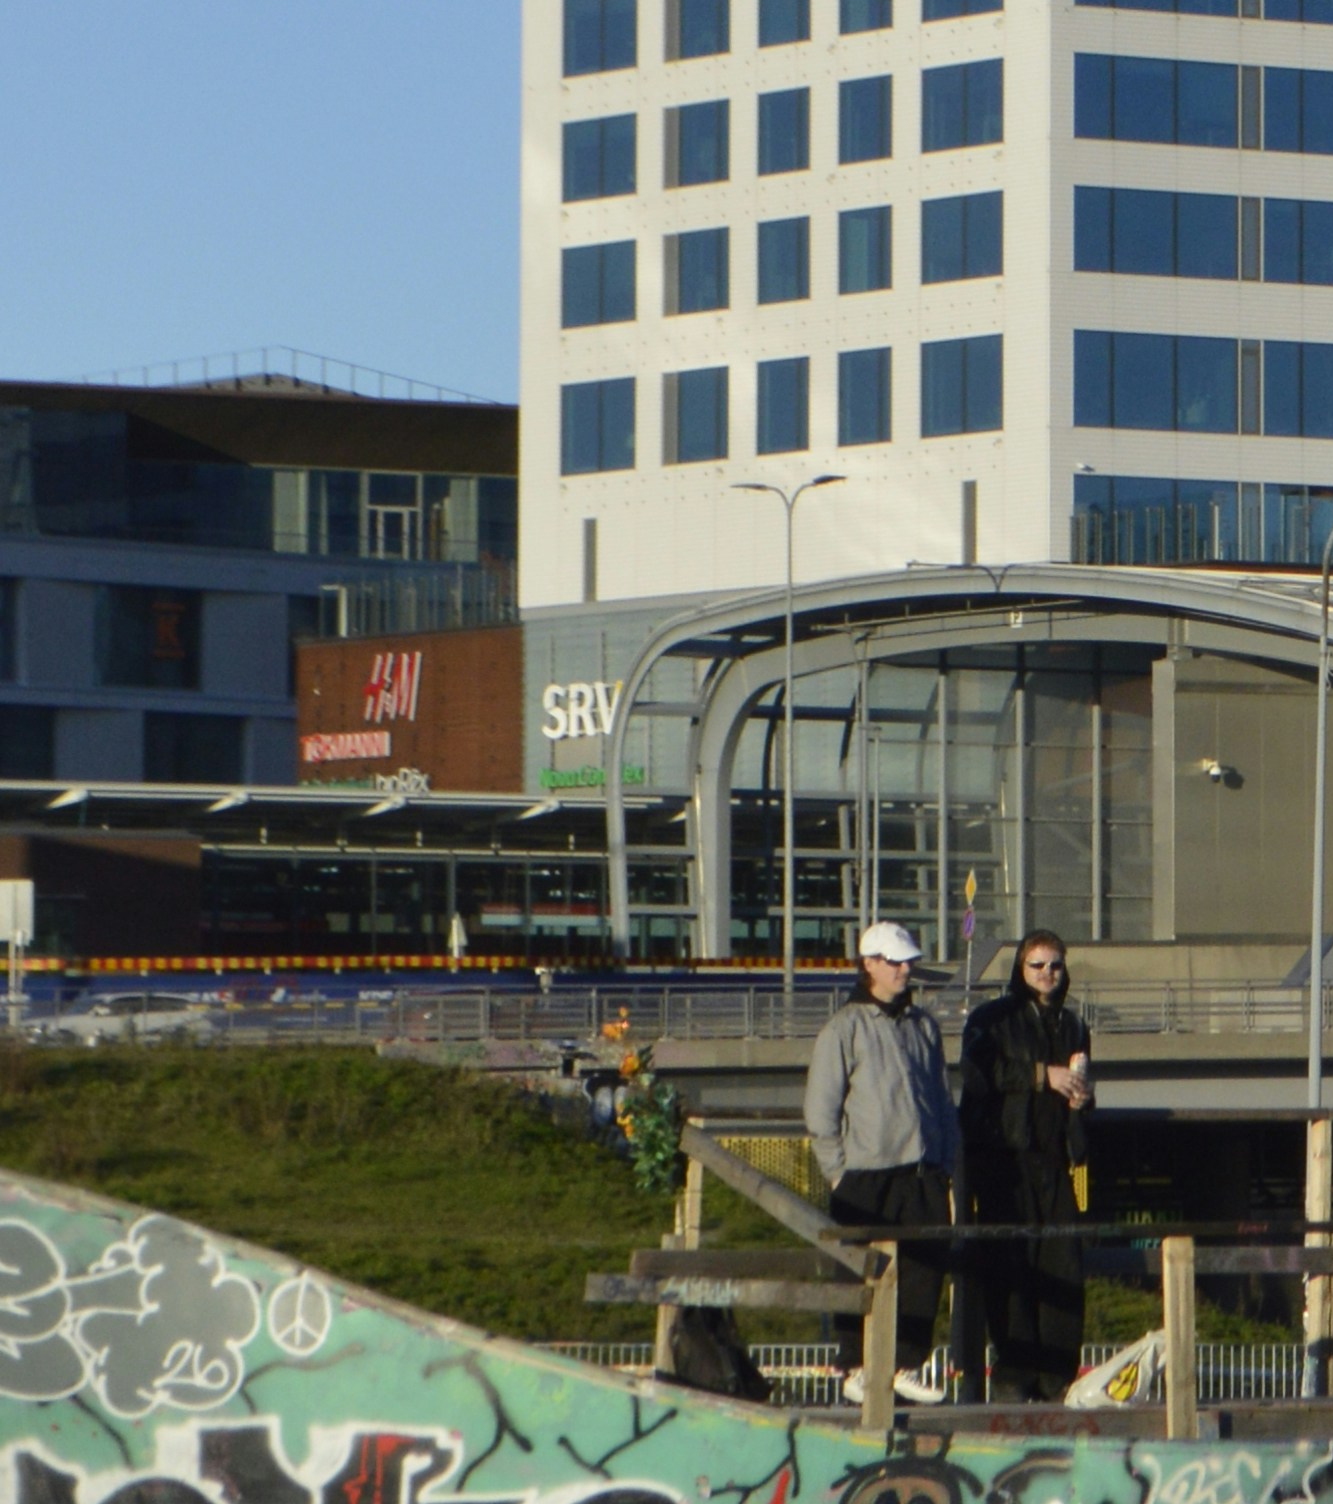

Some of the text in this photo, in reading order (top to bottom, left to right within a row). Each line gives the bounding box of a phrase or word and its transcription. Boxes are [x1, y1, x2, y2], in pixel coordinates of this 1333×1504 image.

[363, 651, 421, 723] H&M
[542, 680, 623, 739] SRV
[153, 1340, 229, 1389] 26
